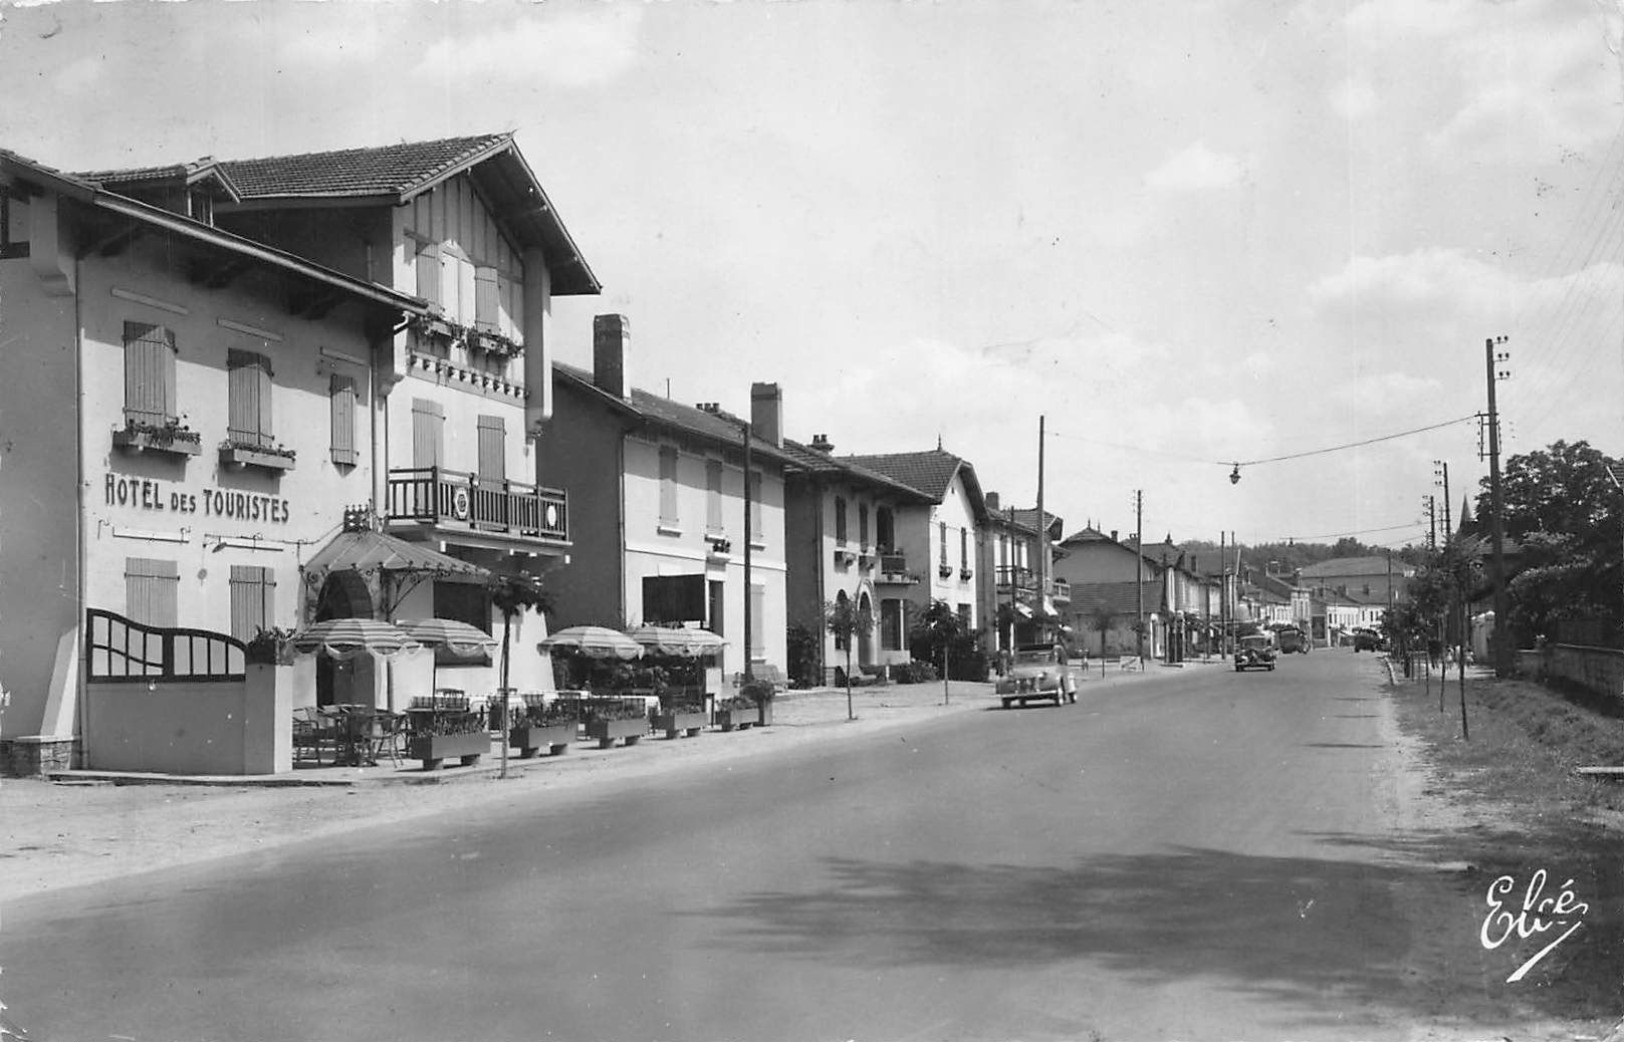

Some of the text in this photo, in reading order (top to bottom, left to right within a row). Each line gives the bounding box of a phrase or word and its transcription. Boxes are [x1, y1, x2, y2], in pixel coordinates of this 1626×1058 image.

[105, 473, 290, 523] HOTEL DES TOURISTES
